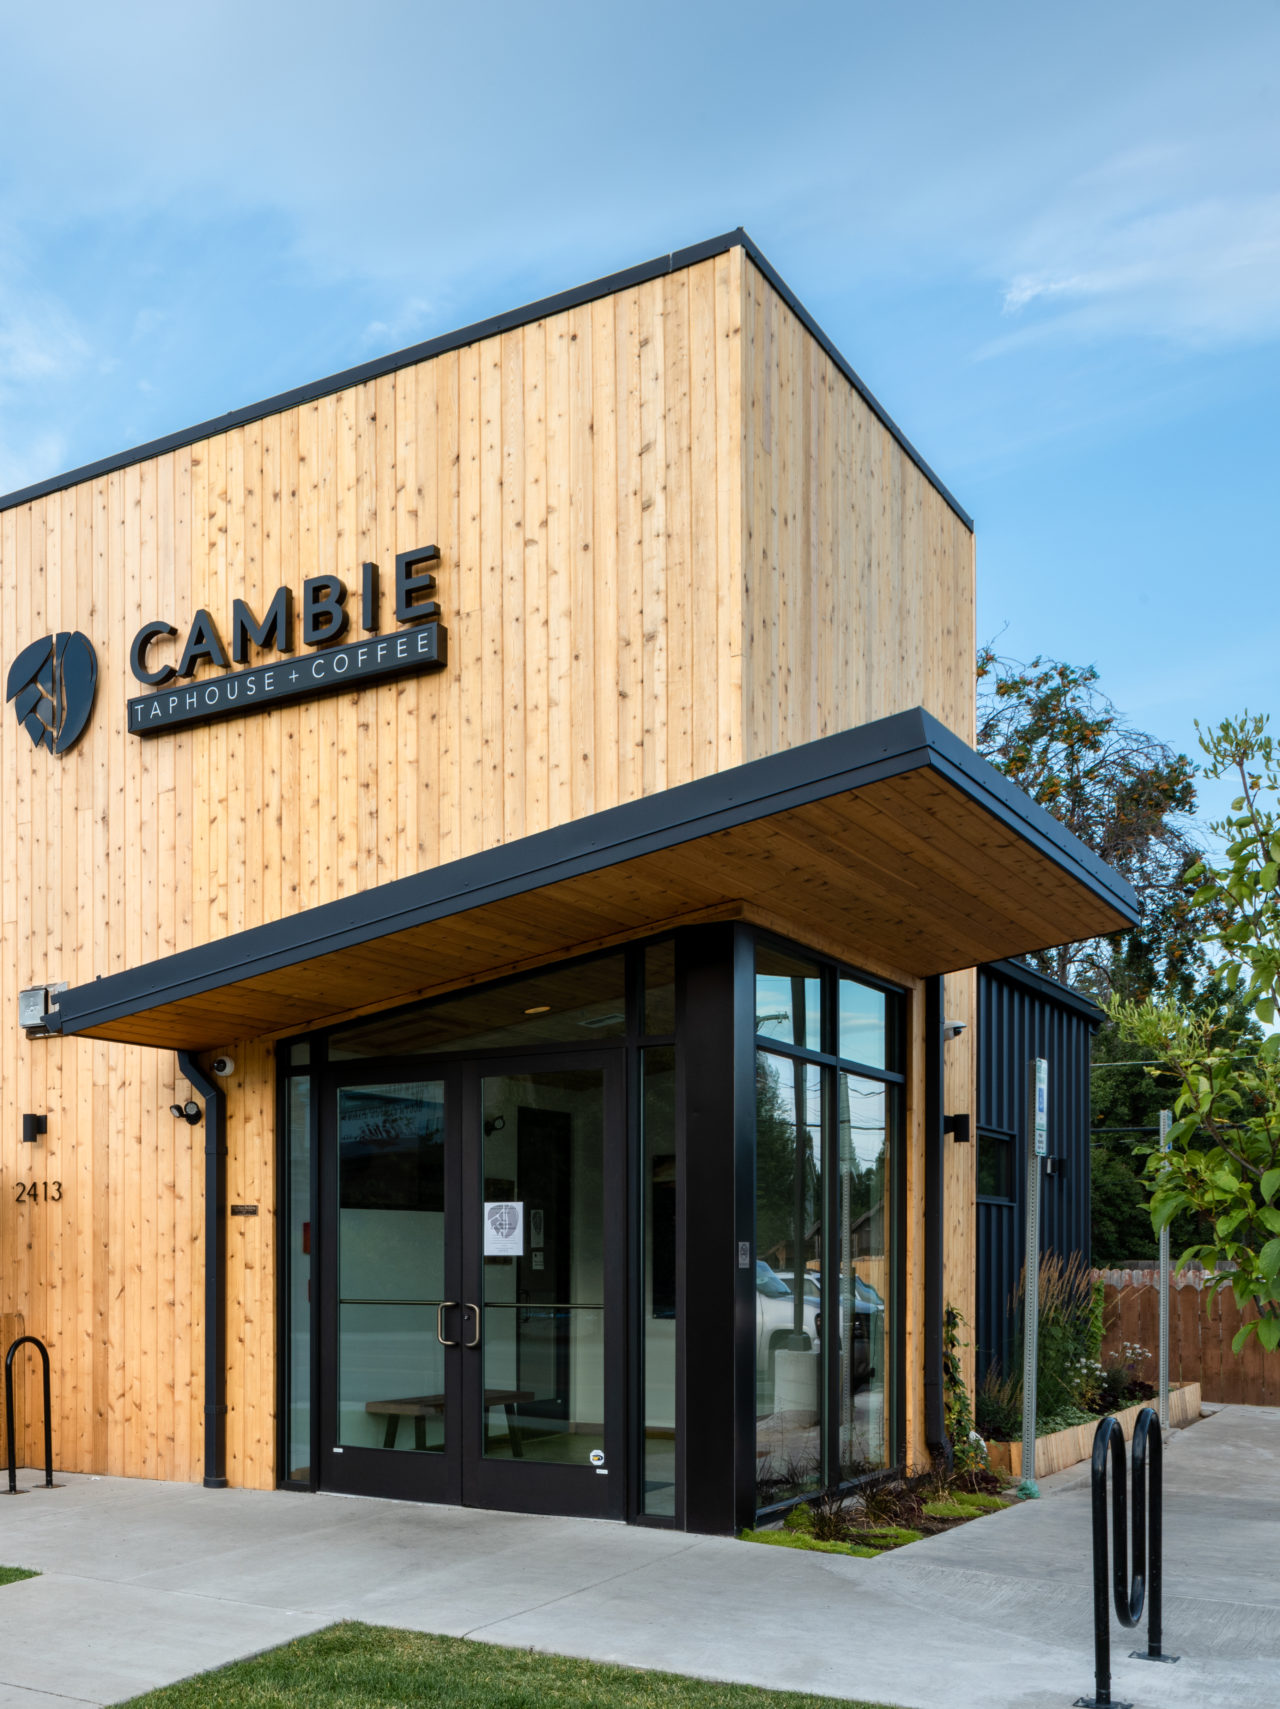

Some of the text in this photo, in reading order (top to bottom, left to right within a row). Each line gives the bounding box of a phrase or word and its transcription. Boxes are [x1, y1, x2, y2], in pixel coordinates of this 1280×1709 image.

[130, 544, 441, 686] CAMBIE
[134, 671, 275, 723] TAPHOUSE
[311, 632, 429, 679] COFFEE
[15, 1180, 63, 1203] 2413
